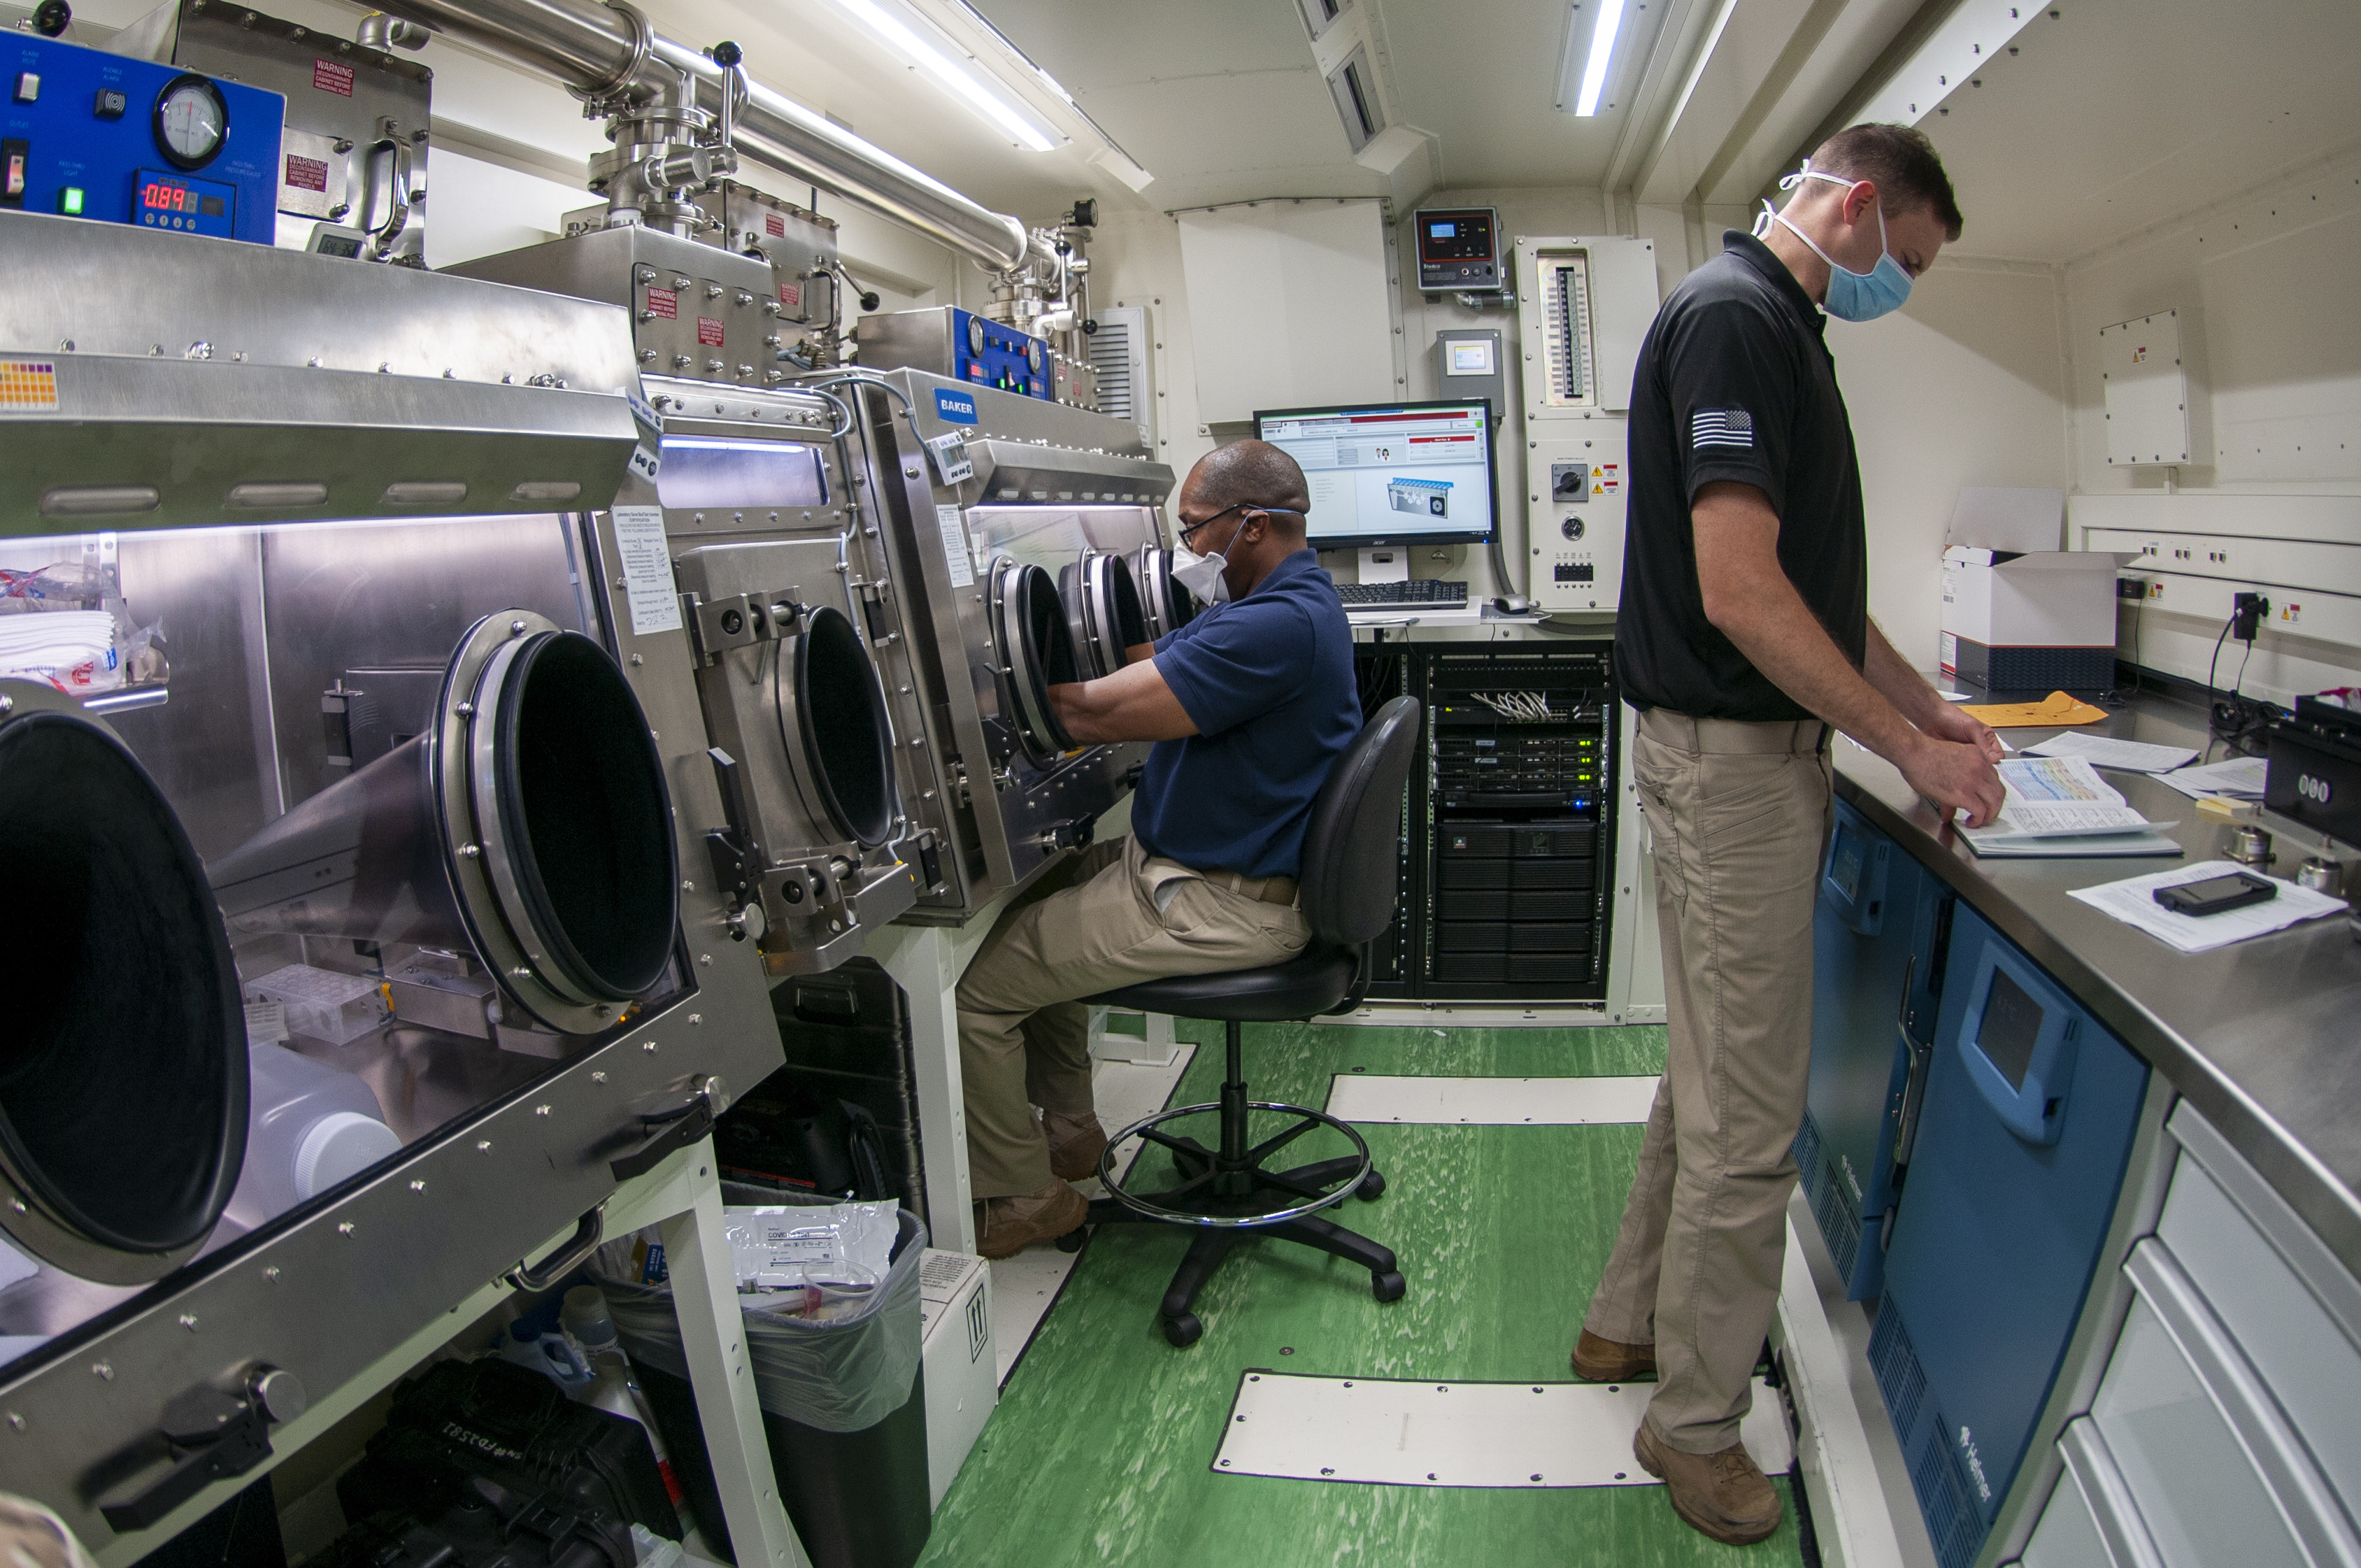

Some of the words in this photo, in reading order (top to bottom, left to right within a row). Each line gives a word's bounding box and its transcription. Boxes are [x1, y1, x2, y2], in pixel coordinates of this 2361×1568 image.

[317, 59, 353, 78] WARNING
[315, 76, 334, 86] CABINET
[334, 80, 351, 90] BEFORE
[317, 71, 351, 84] DECONTAMINATE
[315, 82, 338, 93] REMOVING
[289, 155, 327, 171] WARNING
[289, 169, 308, 178] CABINET
[308, 173, 324, 182] BEFORE
[290, 164, 325, 176] DECONTAMINATE
[290, 175, 313, 184] REMOVING
[649, 288, 676, 301] WARNING
[699, 318, 724, 329] WARNING
[941, 399, 973, 415] BAKER
[1846, 1163, 1863, 1203] Helmer
[1966, 1442, 1992, 1503] Helmer
